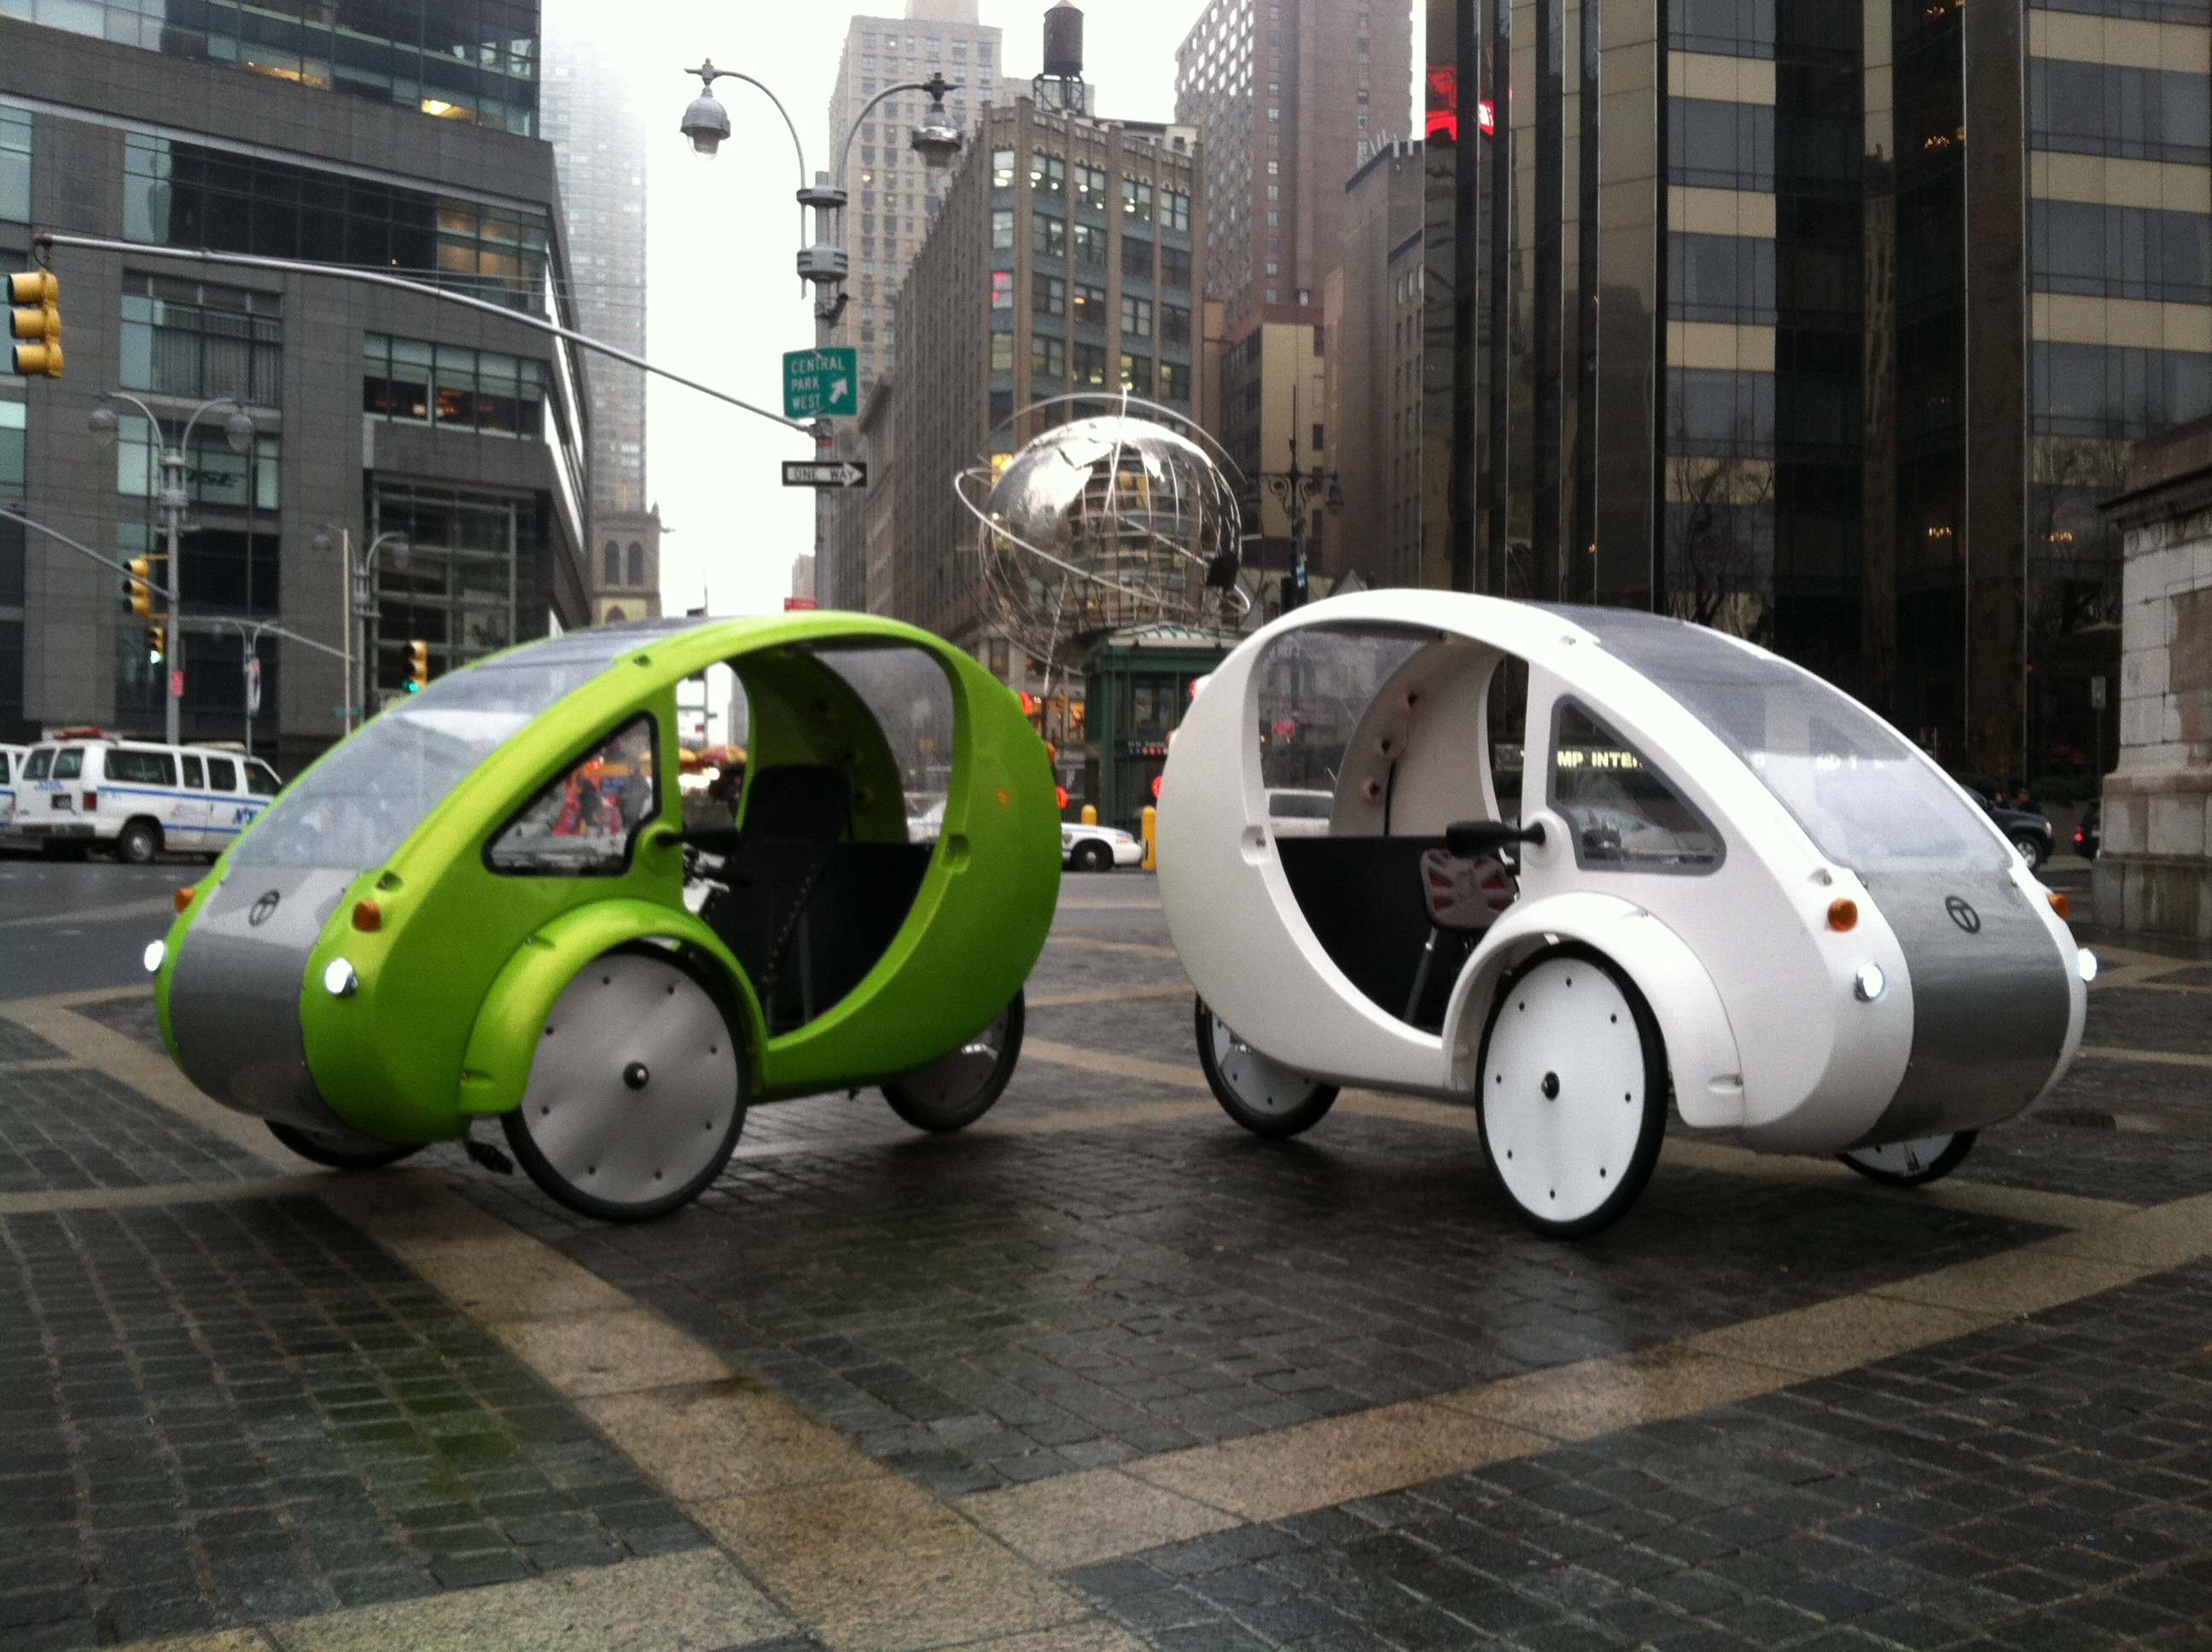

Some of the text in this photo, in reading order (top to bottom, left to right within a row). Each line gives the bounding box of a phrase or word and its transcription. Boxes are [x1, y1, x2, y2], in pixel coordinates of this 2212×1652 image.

[790, 356, 846, 375] CENTRAL
[791, 376, 820, 393] PARK
[792, 393, 821, 410] WEST
[794, 467, 855, 482] ONE WAY
